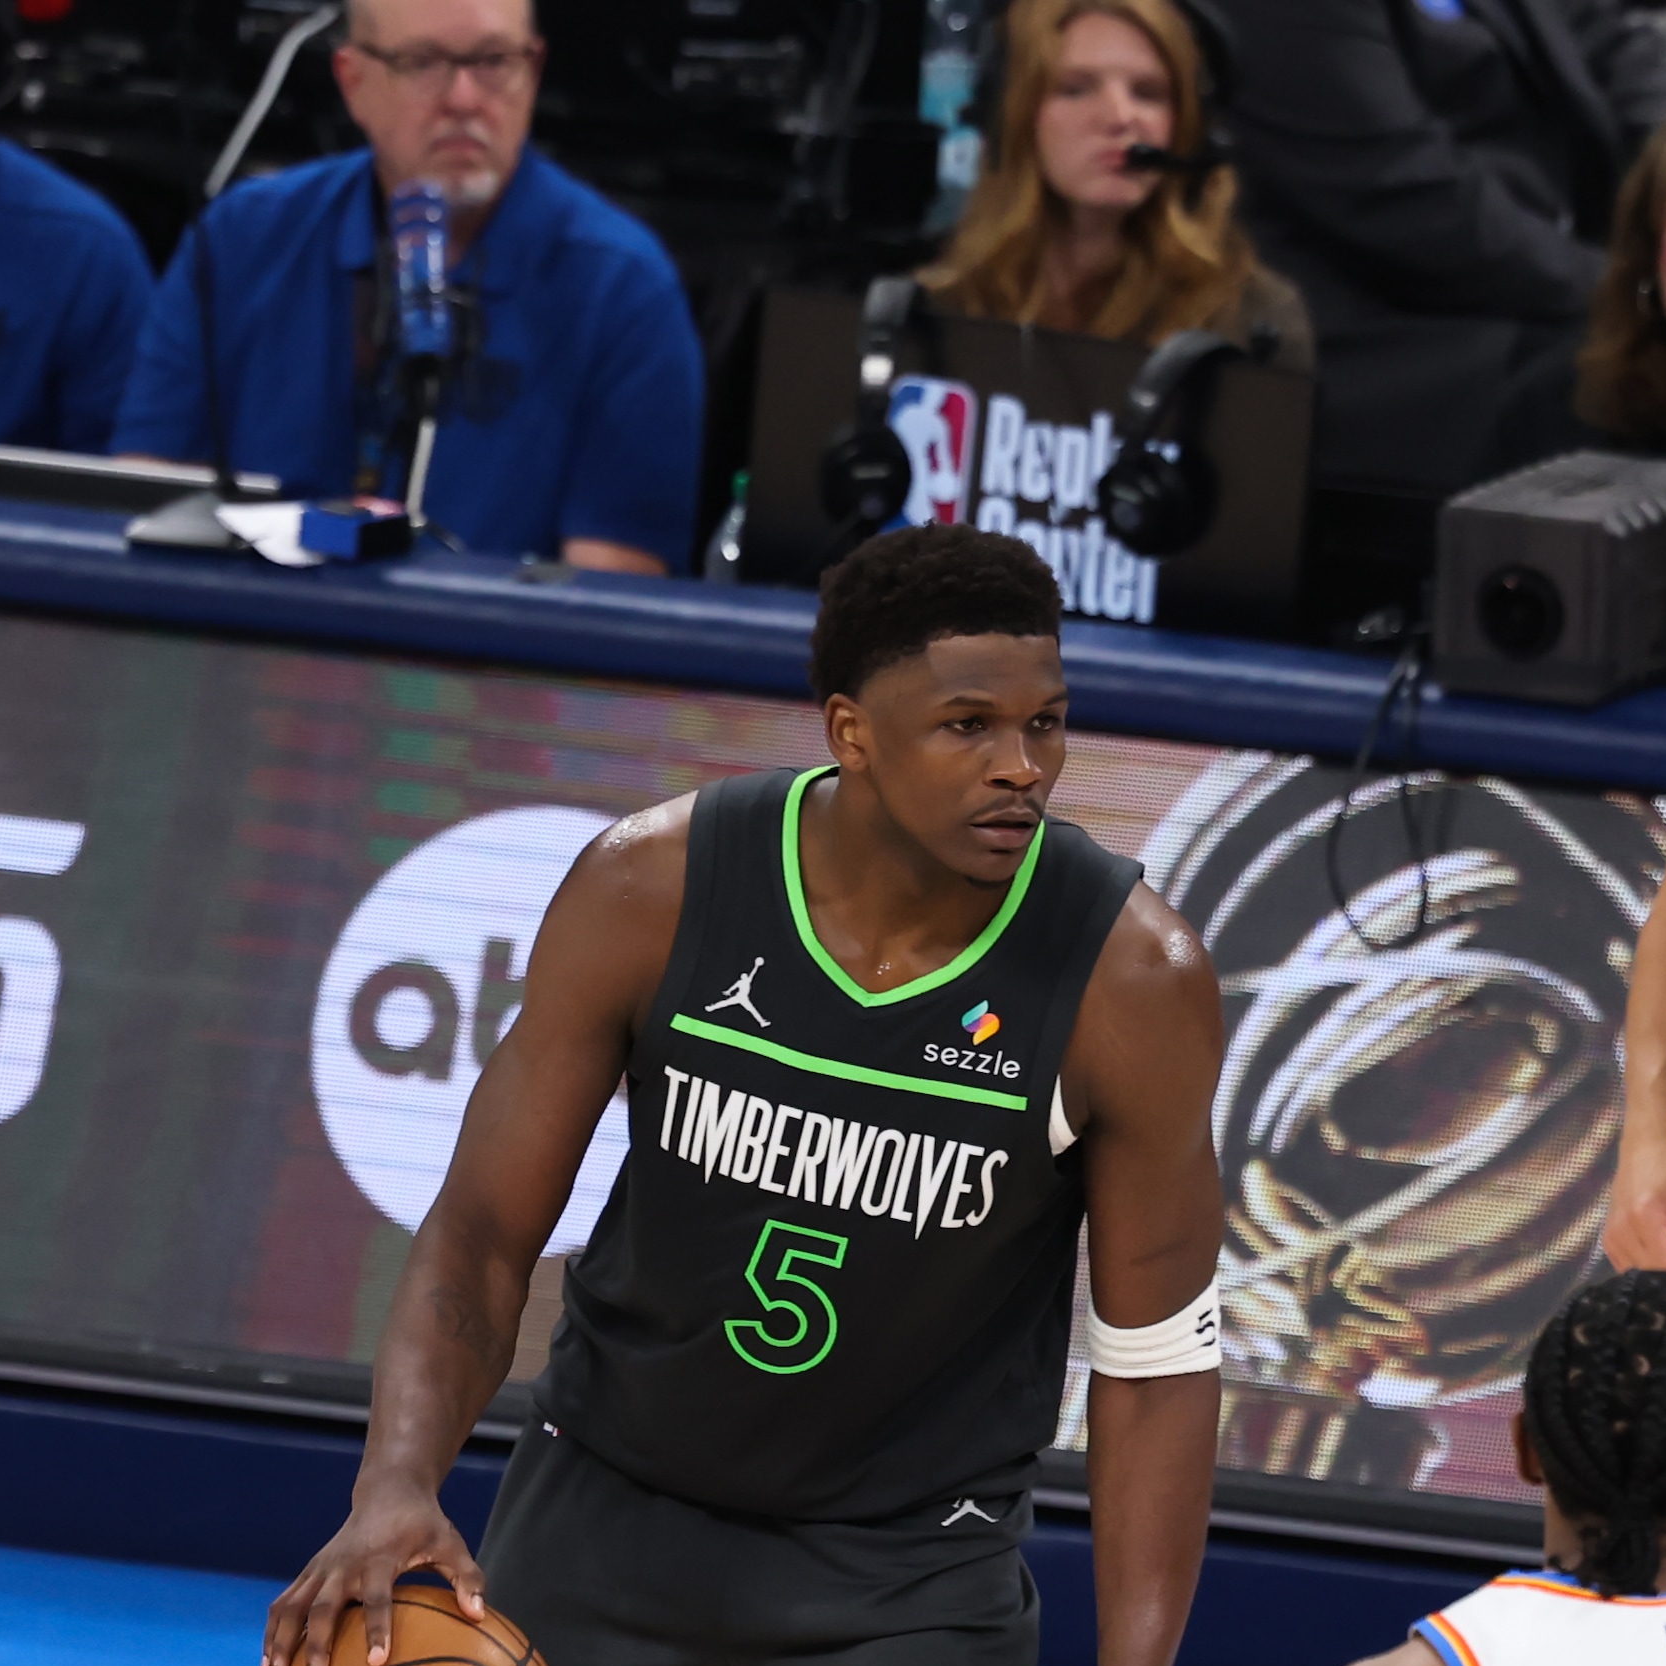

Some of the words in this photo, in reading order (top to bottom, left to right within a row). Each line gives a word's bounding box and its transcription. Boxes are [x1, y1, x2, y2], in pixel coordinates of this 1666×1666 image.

[980, 393, 1182, 524] Repl
[923, 1043, 1021, 1079] sezzle
[658, 1064, 1010, 1241] TIMBERWOLVES
[724, 1218, 850, 1376] 5
